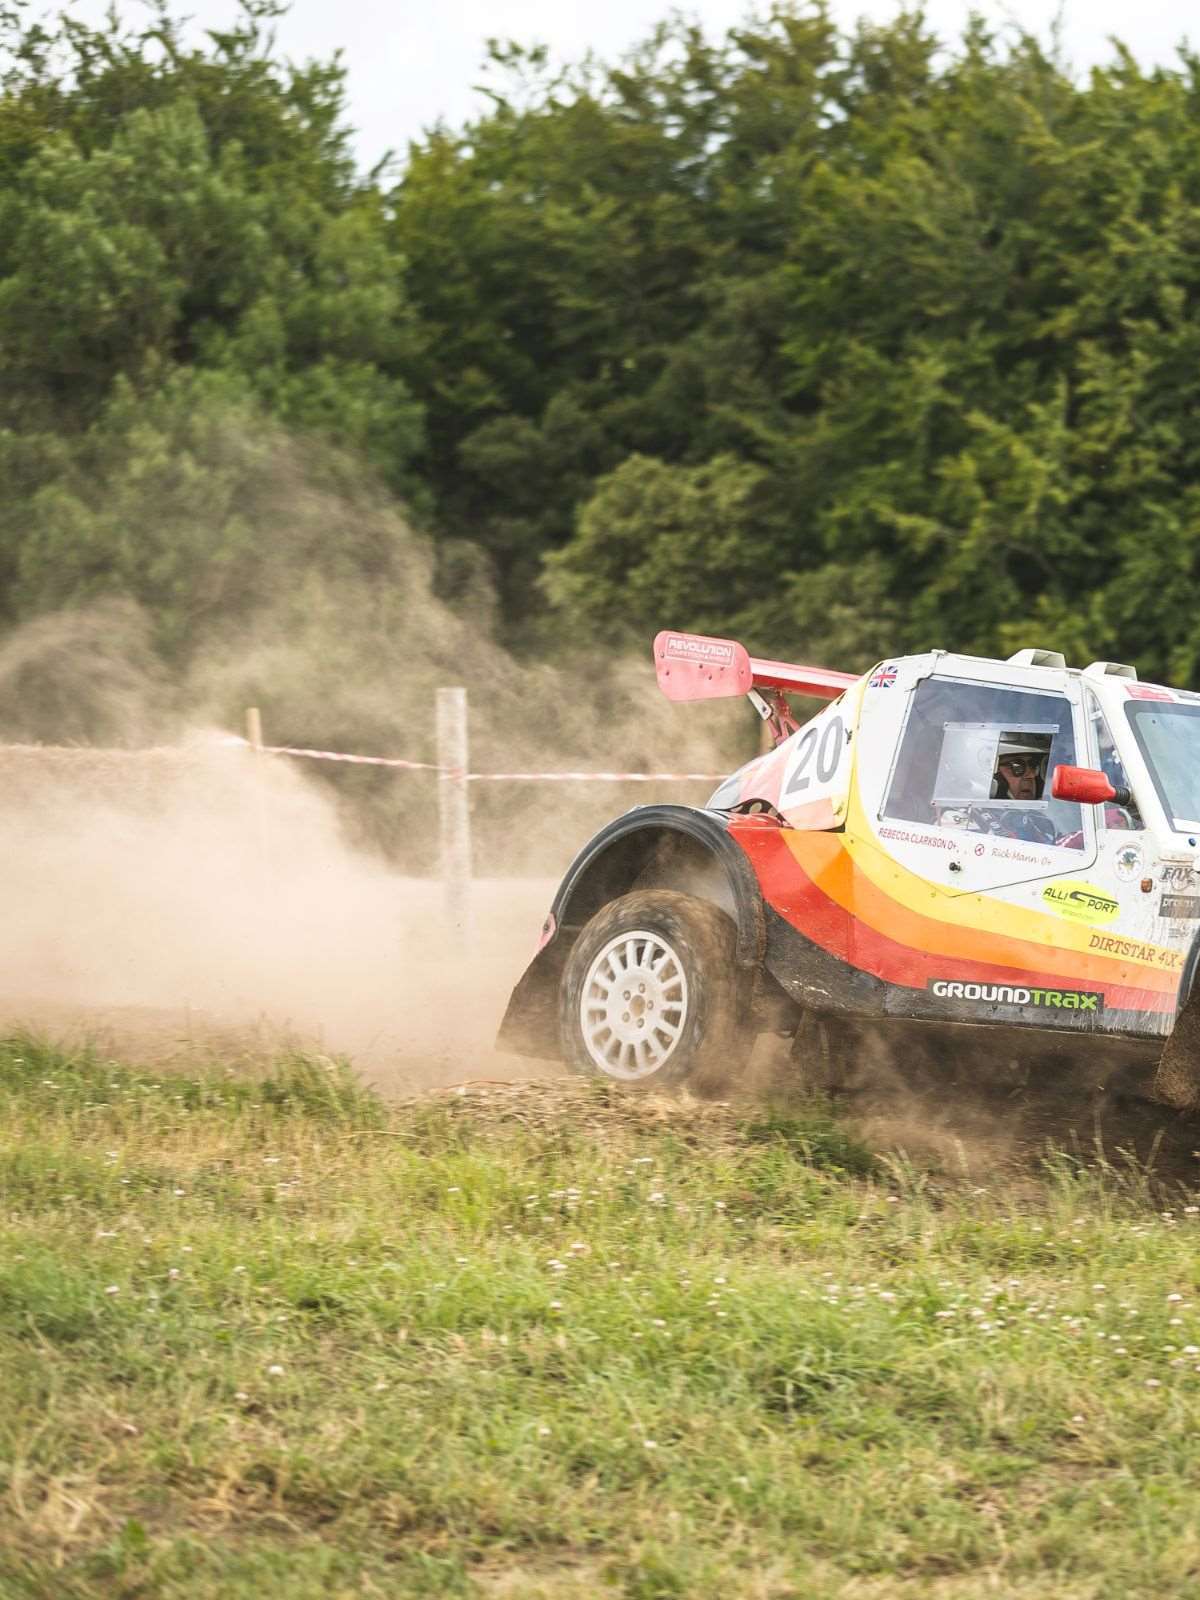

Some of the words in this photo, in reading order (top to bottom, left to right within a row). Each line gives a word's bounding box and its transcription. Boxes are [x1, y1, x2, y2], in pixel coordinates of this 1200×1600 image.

[668, 638, 732, 657] REVOLUTION
[785, 715, 844, 795] 20
[879, 827, 910, 841] REBECCA
[910, 833, 947, 849] CLARKSON
[1088, 934, 1156, 962] DIRTSTAR
